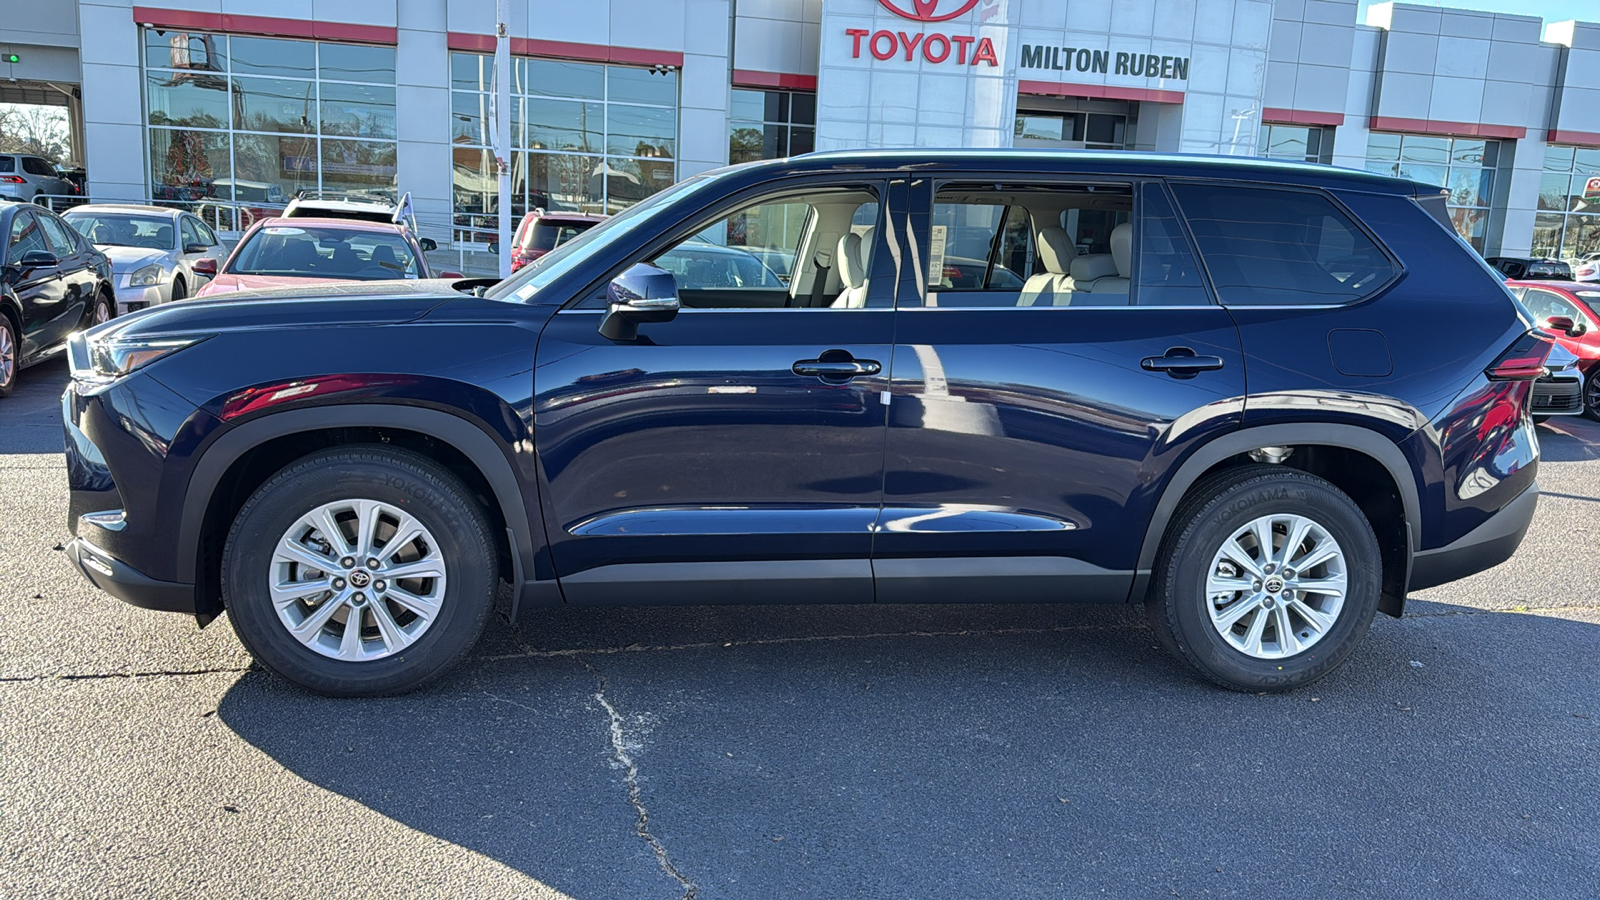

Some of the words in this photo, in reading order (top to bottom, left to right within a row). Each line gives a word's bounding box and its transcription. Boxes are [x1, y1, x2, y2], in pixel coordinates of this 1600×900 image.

[846, 28, 999, 67] TOYOTA
[1020, 44, 1108, 74] MILTON
[1114, 52, 1189, 80] RUBEN
[1212, 488, 1290, 528] YOKOHAMA
[1299, 581, 1374, 681] GEOLANDAR
